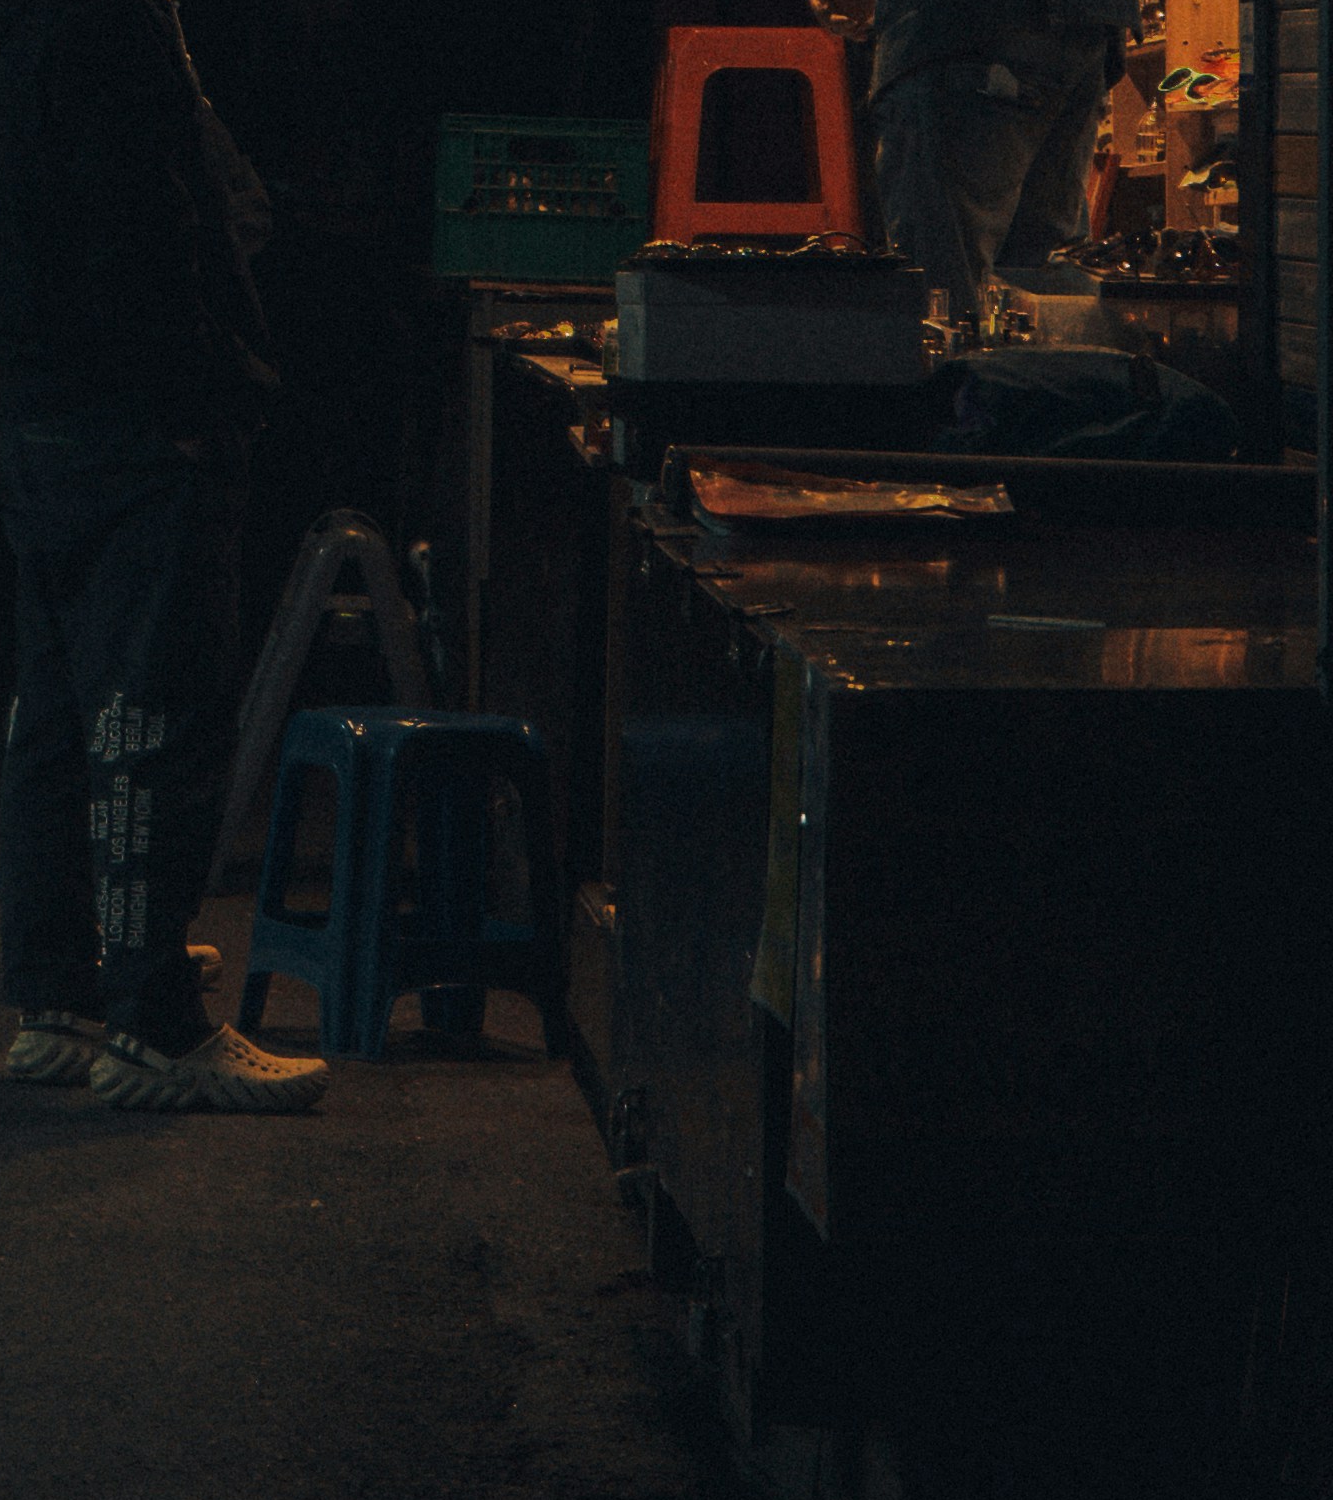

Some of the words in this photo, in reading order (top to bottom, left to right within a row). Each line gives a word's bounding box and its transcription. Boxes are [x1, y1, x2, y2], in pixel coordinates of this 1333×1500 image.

[126, 706, 143, 751] BERLIN
[97, 801, 108, 838] MILAN
[113, 776, 129, 833] ANGELES
[134, 788, 152, 820] YORK
[112, 837, 126, 863] LOS
[133, 823, 150, 853] NEW
[109, 888, 125, 941] LONDON
[128, 880, 147, 947] SHANGHAI
